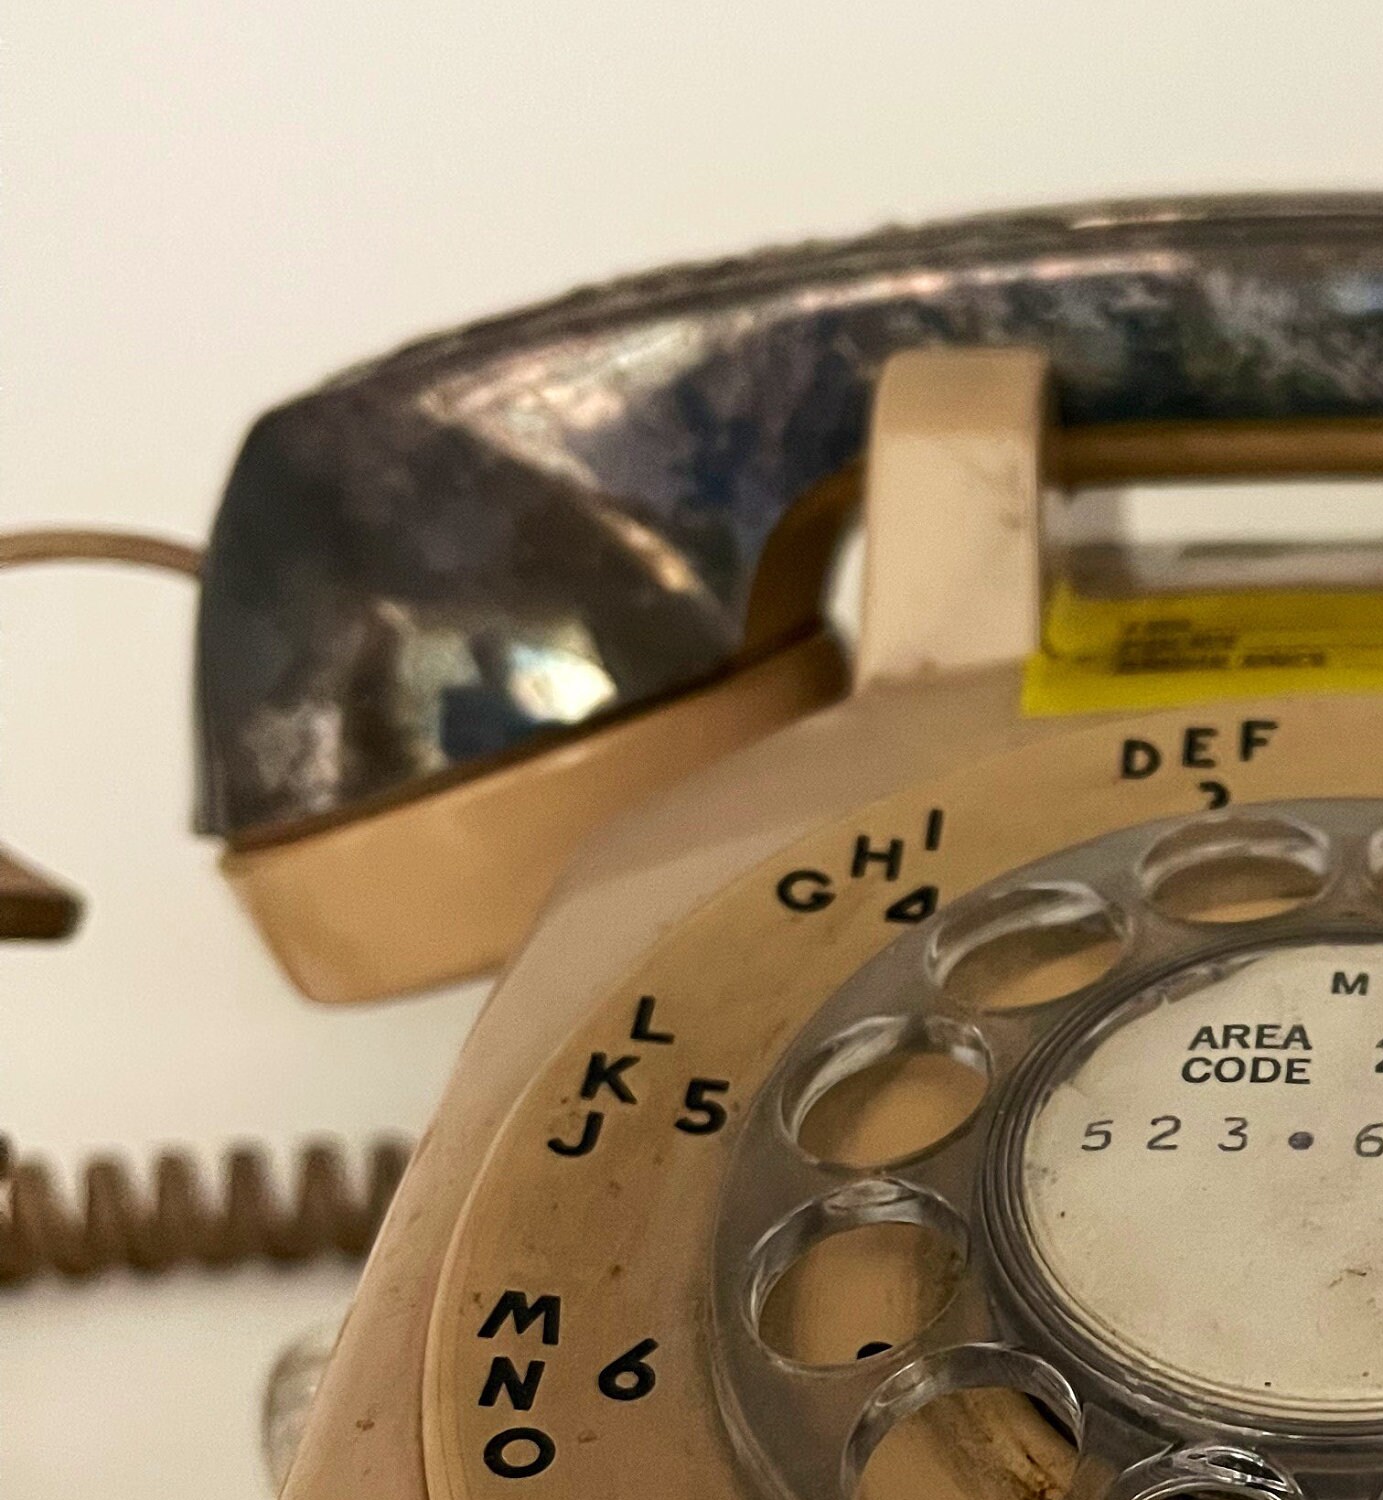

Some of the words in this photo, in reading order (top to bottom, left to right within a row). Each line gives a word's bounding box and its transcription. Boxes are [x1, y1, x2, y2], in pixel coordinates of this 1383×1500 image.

[1121, 719, 1279, 780] DEF
[775, 809, 945, 913] GHI
[1331, 971, 1370, 996] M
[1188, 1024, 1312, 1051] AREA
[1181, 1056, 1312, 1085] CODE
[675, 1077, 730, 1135] 5
[477, 1290, 562, 1479] MNO
[600, 1338, 659, 1400] 6
